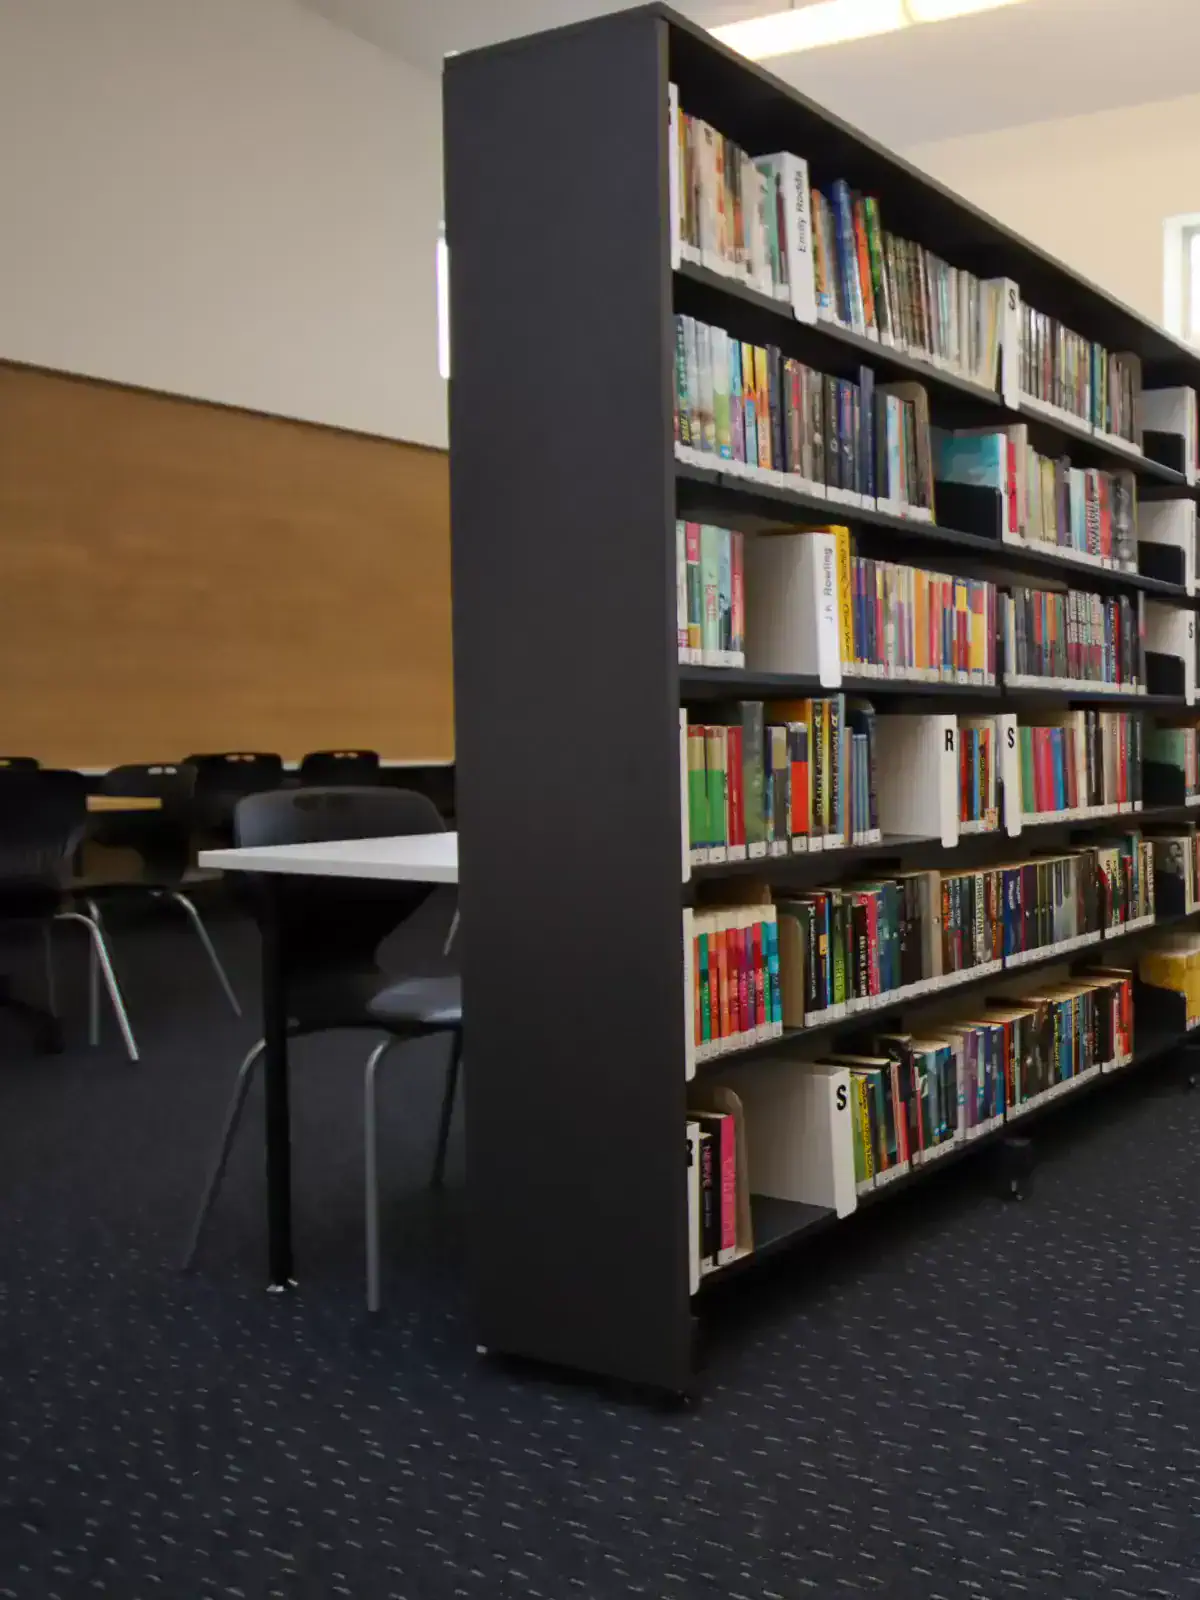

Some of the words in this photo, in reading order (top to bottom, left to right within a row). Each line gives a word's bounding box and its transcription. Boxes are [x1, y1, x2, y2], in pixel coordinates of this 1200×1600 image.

[795, 170, 804, 212] Rodda
[797, 216, 807, 254] Emily
[1008, 287, 1016, 311] S
[823, 547, 833, 597] Rowling
[944, 728, 954, 752] R
[1007, 726, 1015, 749] S
[975, 877, 985, 905] CHRIS
[976, 907, 985, 935] RYAN
[836, 1084, 847, 1111] S
